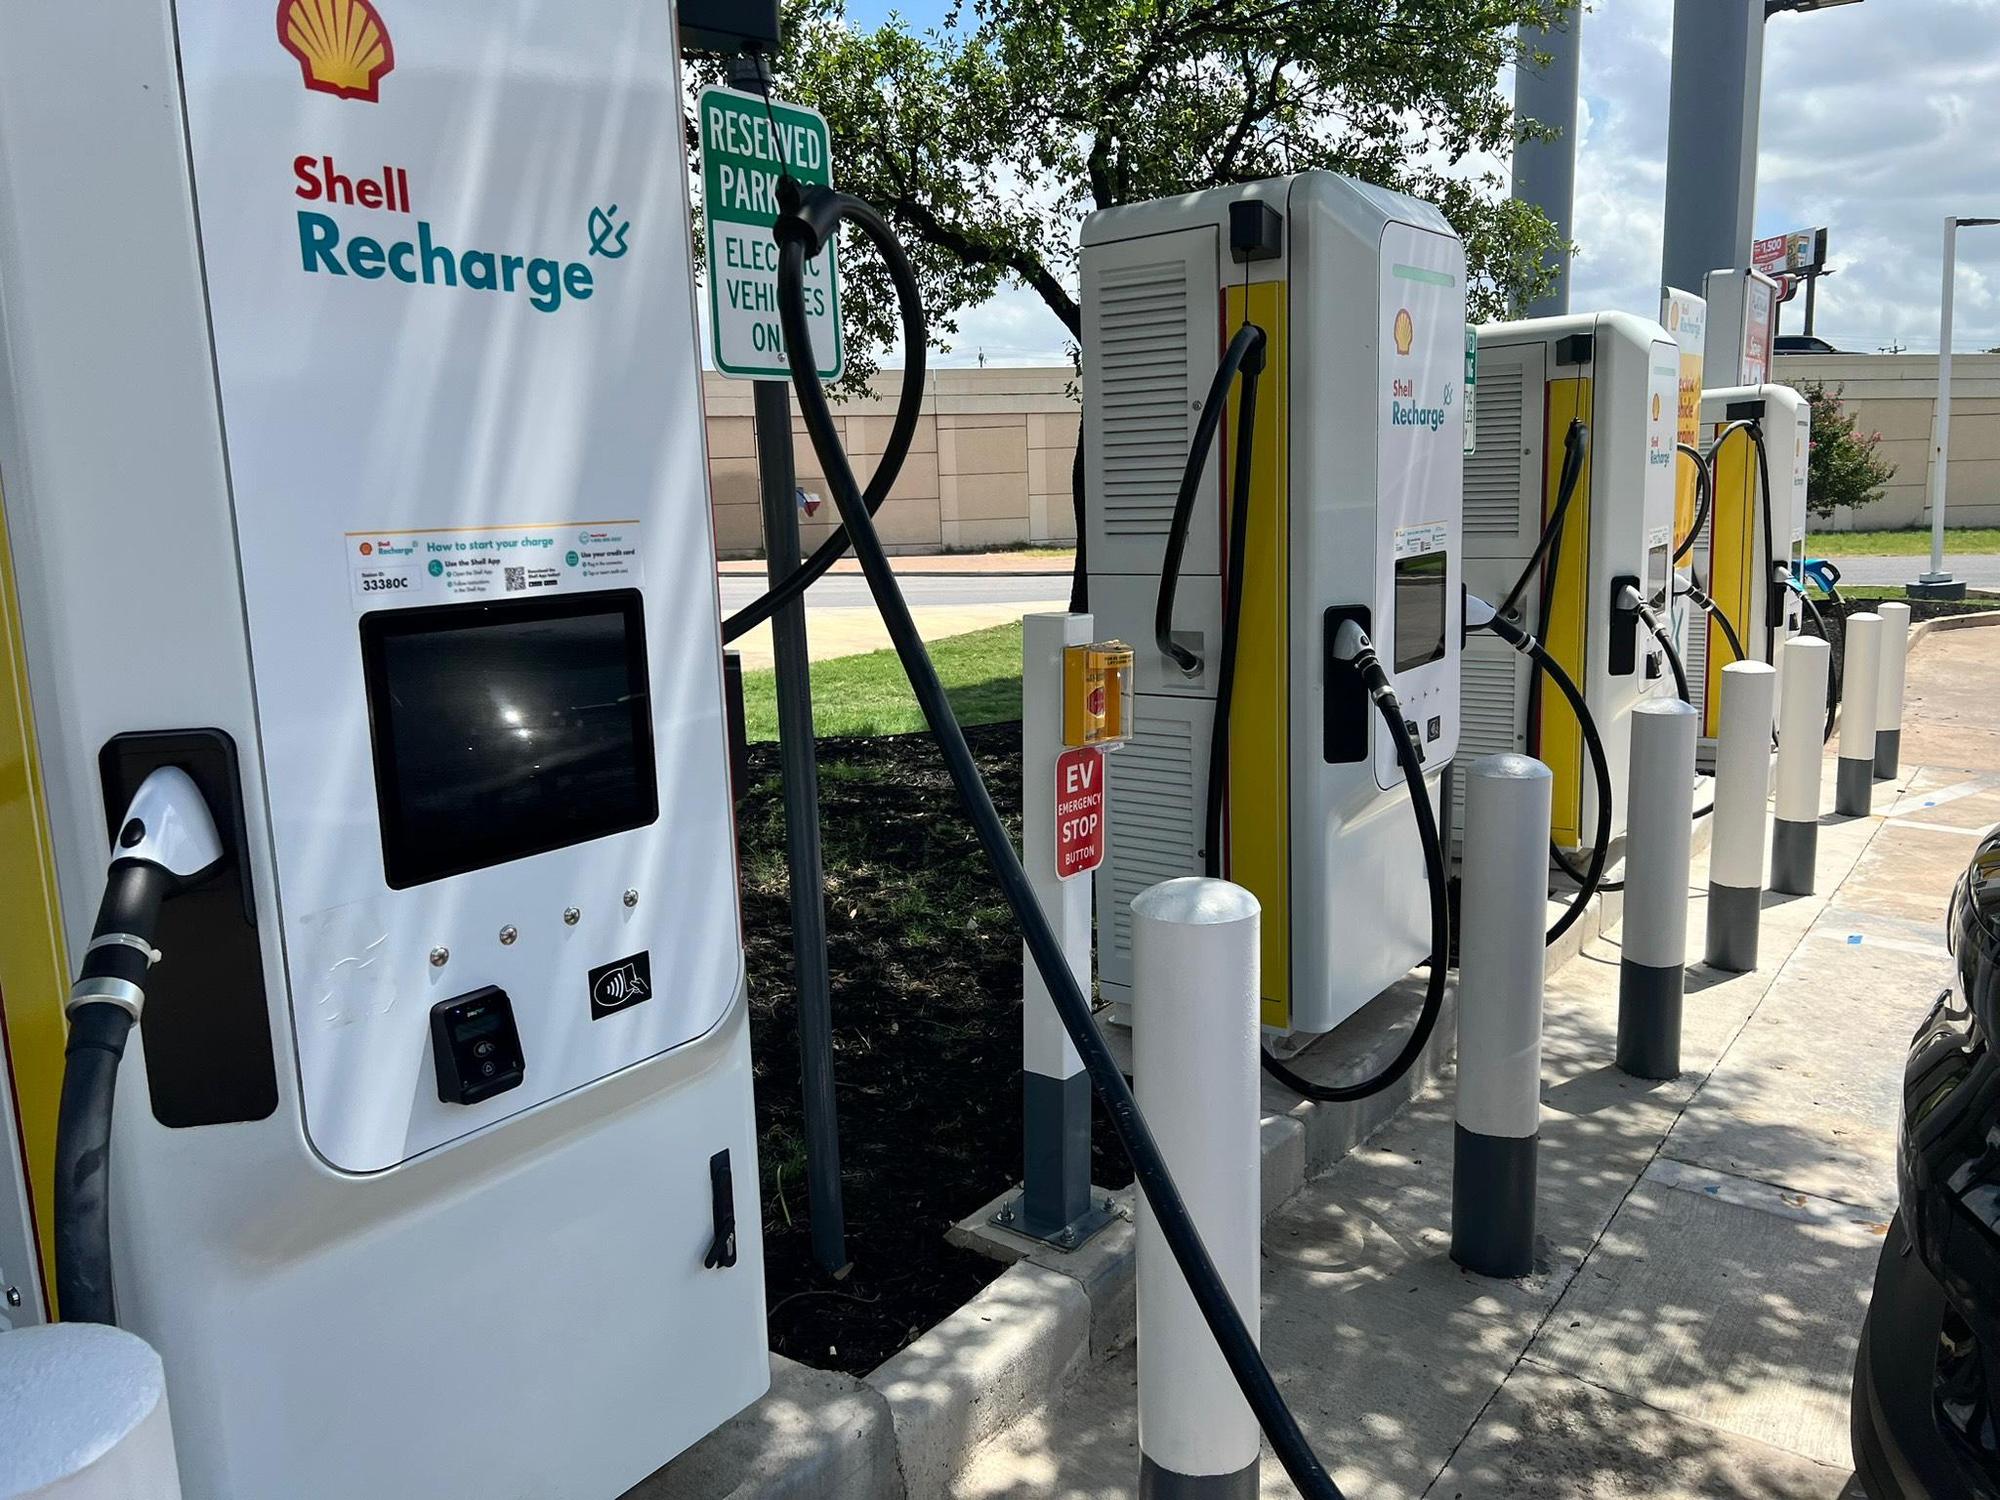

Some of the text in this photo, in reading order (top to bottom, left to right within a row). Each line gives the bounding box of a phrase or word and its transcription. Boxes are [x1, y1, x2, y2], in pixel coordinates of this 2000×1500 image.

[708, 106, 822, 170] RESERVED
[293, 155, 411, 214] Shell
[296, 210, 594, 313] Recharge
[726, 237, 820, 277] ELECIC
[726, 279, 825, 317] VEHIES
[1393, 379, 1413, 398] Shell
[1393, 400, 1445, 432] Recharge
[426, 536, 554, 552] How to start your charge
[363, 578, 408, 591] 33380C
[1066, 760, 1095, 793] EV
[1058, 791, 1102, 816] EMERGENCY
[1062, 813, 1098, 843] STOP
[1065, 845, 1095, 866] BUTTON
